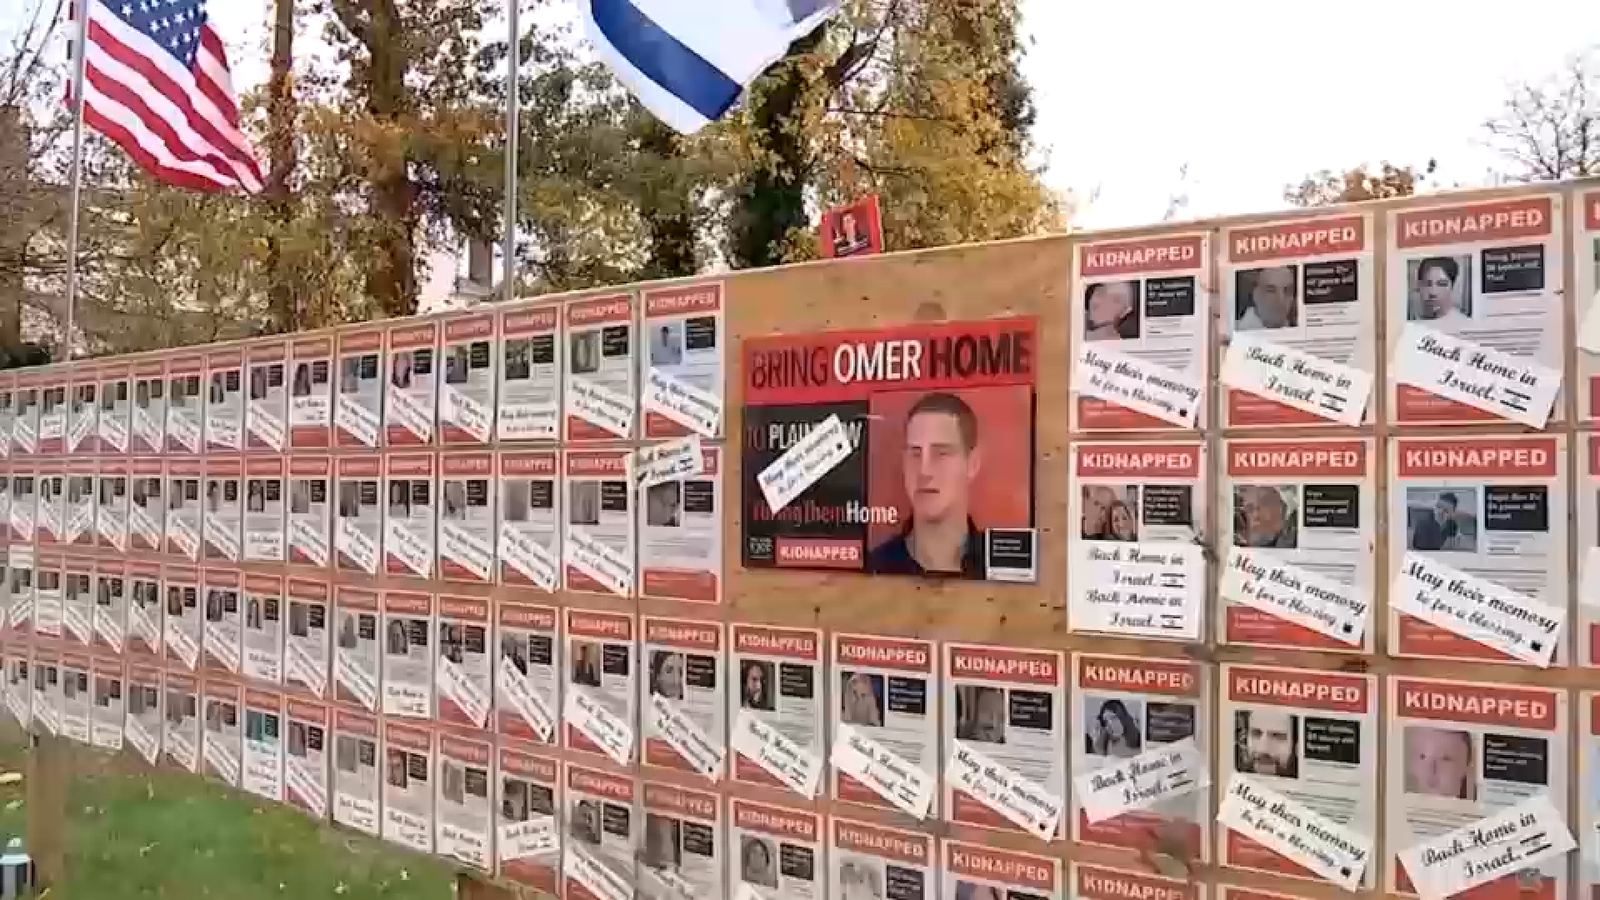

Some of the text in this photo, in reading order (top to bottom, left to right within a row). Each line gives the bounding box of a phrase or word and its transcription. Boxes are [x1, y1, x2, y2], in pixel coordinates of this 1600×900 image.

[1405, 208, 1543, 239] KIDNAPPED
[1236, 226, 1356, 254] KIDNAPPED
[1086, 245, 1194, 268] KIDNAPPED
[752, 331, 1032, 390] BRING OMER HOME
[1246, 345, 1287, 368] Back
[1287, 359, 1334, 383] Home
[1417, 336, 1538, 387] Back Home in
[1080, 350, 1113, 374] May
[1146, 375, 1199, 403] memory
[1082, 451, 1193, 470] KIDNAPPED
[1234, 450, 1358, 469] KIDNAPPED
[1406, 449, 1547, 468] KIDNAPPED
[1229, 554, 1367, 616] May their memory
[1401, 561, 1559, 634] May their memory
[840, 644, 926, 666] KIDNAPPED
[954, 655, 1052, 677] KIDNAPPED
[1085, 664, 1194, 689] KIDNAPPED
[1235, 676, 1360, 702] KIDNAPPED
[1405, 690, 1547, 719] KIDNAPPED
[1230, 782, 1366, 861] May their memory
[1421, 812, 1537, 868] Back Home in
[953, 850, 1049, 881] KIDNAPPED
